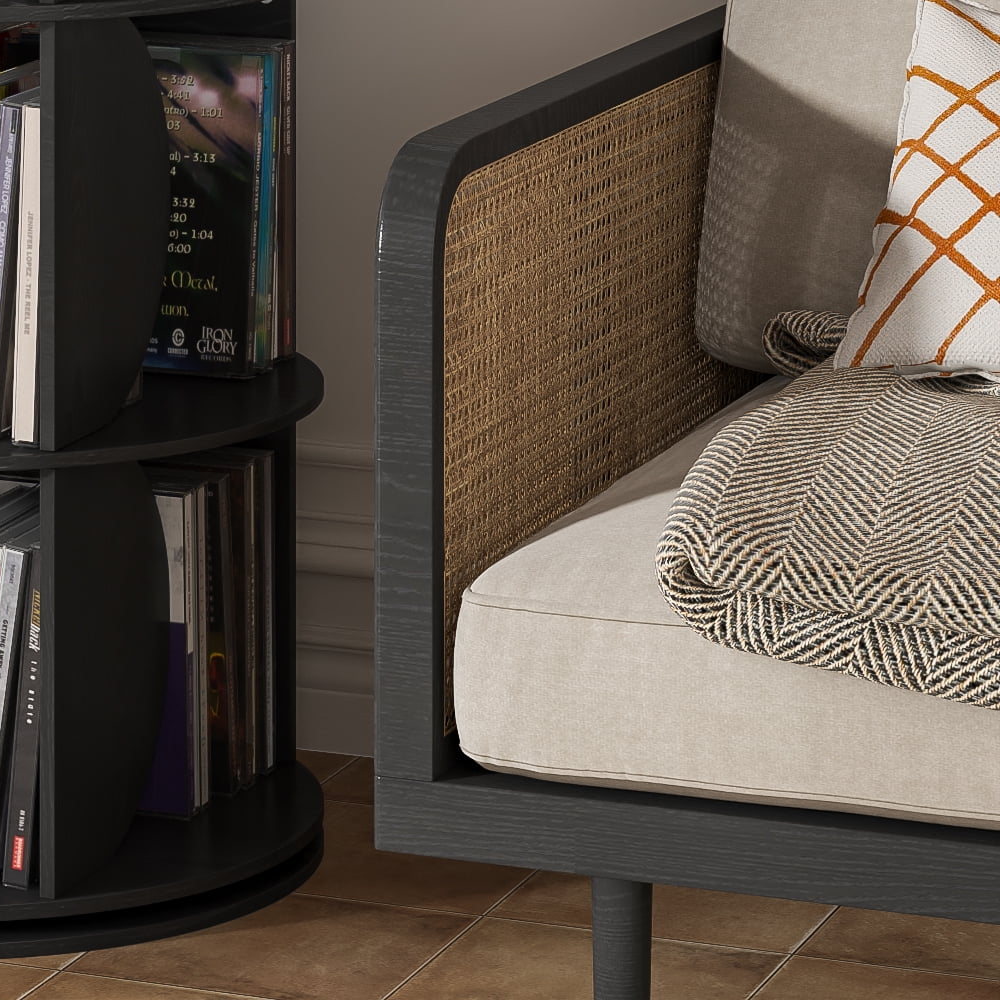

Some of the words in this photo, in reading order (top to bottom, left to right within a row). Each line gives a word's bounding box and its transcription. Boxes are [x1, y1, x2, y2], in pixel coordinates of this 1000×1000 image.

[200, 107, 224, 118] 1:01
[192, 153, 216, 163] 3:13
[2, 155, 13, 189] JENNIFER
[0, 190, 10, 215] LOPEZ
[172, 197, 196, 208] 3:32
[26, 211, 34, 250] JENNIFER
[191, 229, 214, 240] 1:04
[167, 243, 192, 254] 6:00
[25, 251, 33, 276] LOPEZ
[24, 323, 31, 335] ME
[201, 326, 233, 342] IRON
[196, 338, 238, 356] GLORY
[0, 619, 9, 648] GETTING
[29, 660, 38, 681] the
[25, 689, 35, 725] state
